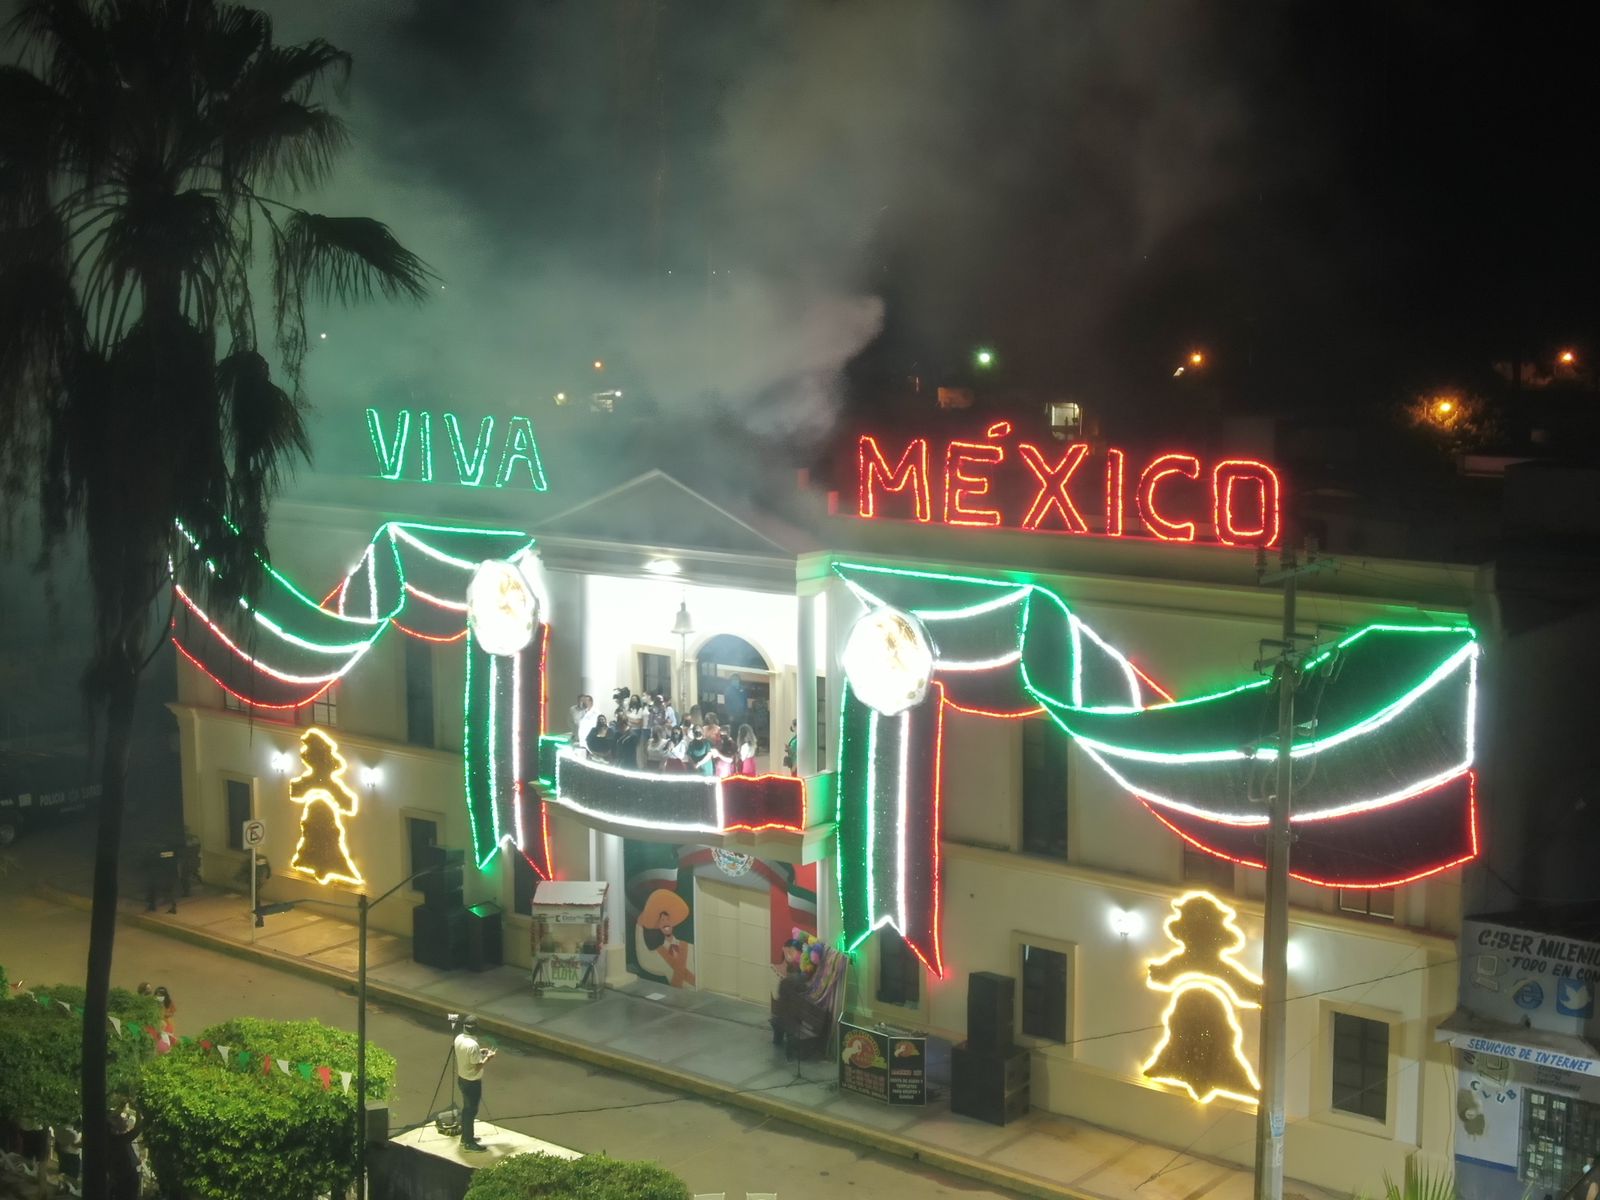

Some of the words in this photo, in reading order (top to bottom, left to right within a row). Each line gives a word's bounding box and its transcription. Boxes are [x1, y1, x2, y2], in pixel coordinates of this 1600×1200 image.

[366, 408, 547, 491] VIVA
[859, 421, 1279, 547] MÉXICO
[1478, 929, 1533, 954] CIBER
[1512, 956, 1547, 973] TODO
[1552, 963, 1573, 978] EN
[1468, 1038, 1516, 1057] SERVICIOS
[1518, 1048, 1532, 1060] DE
[1535, 1050, 1592, 1072] INTERNET
